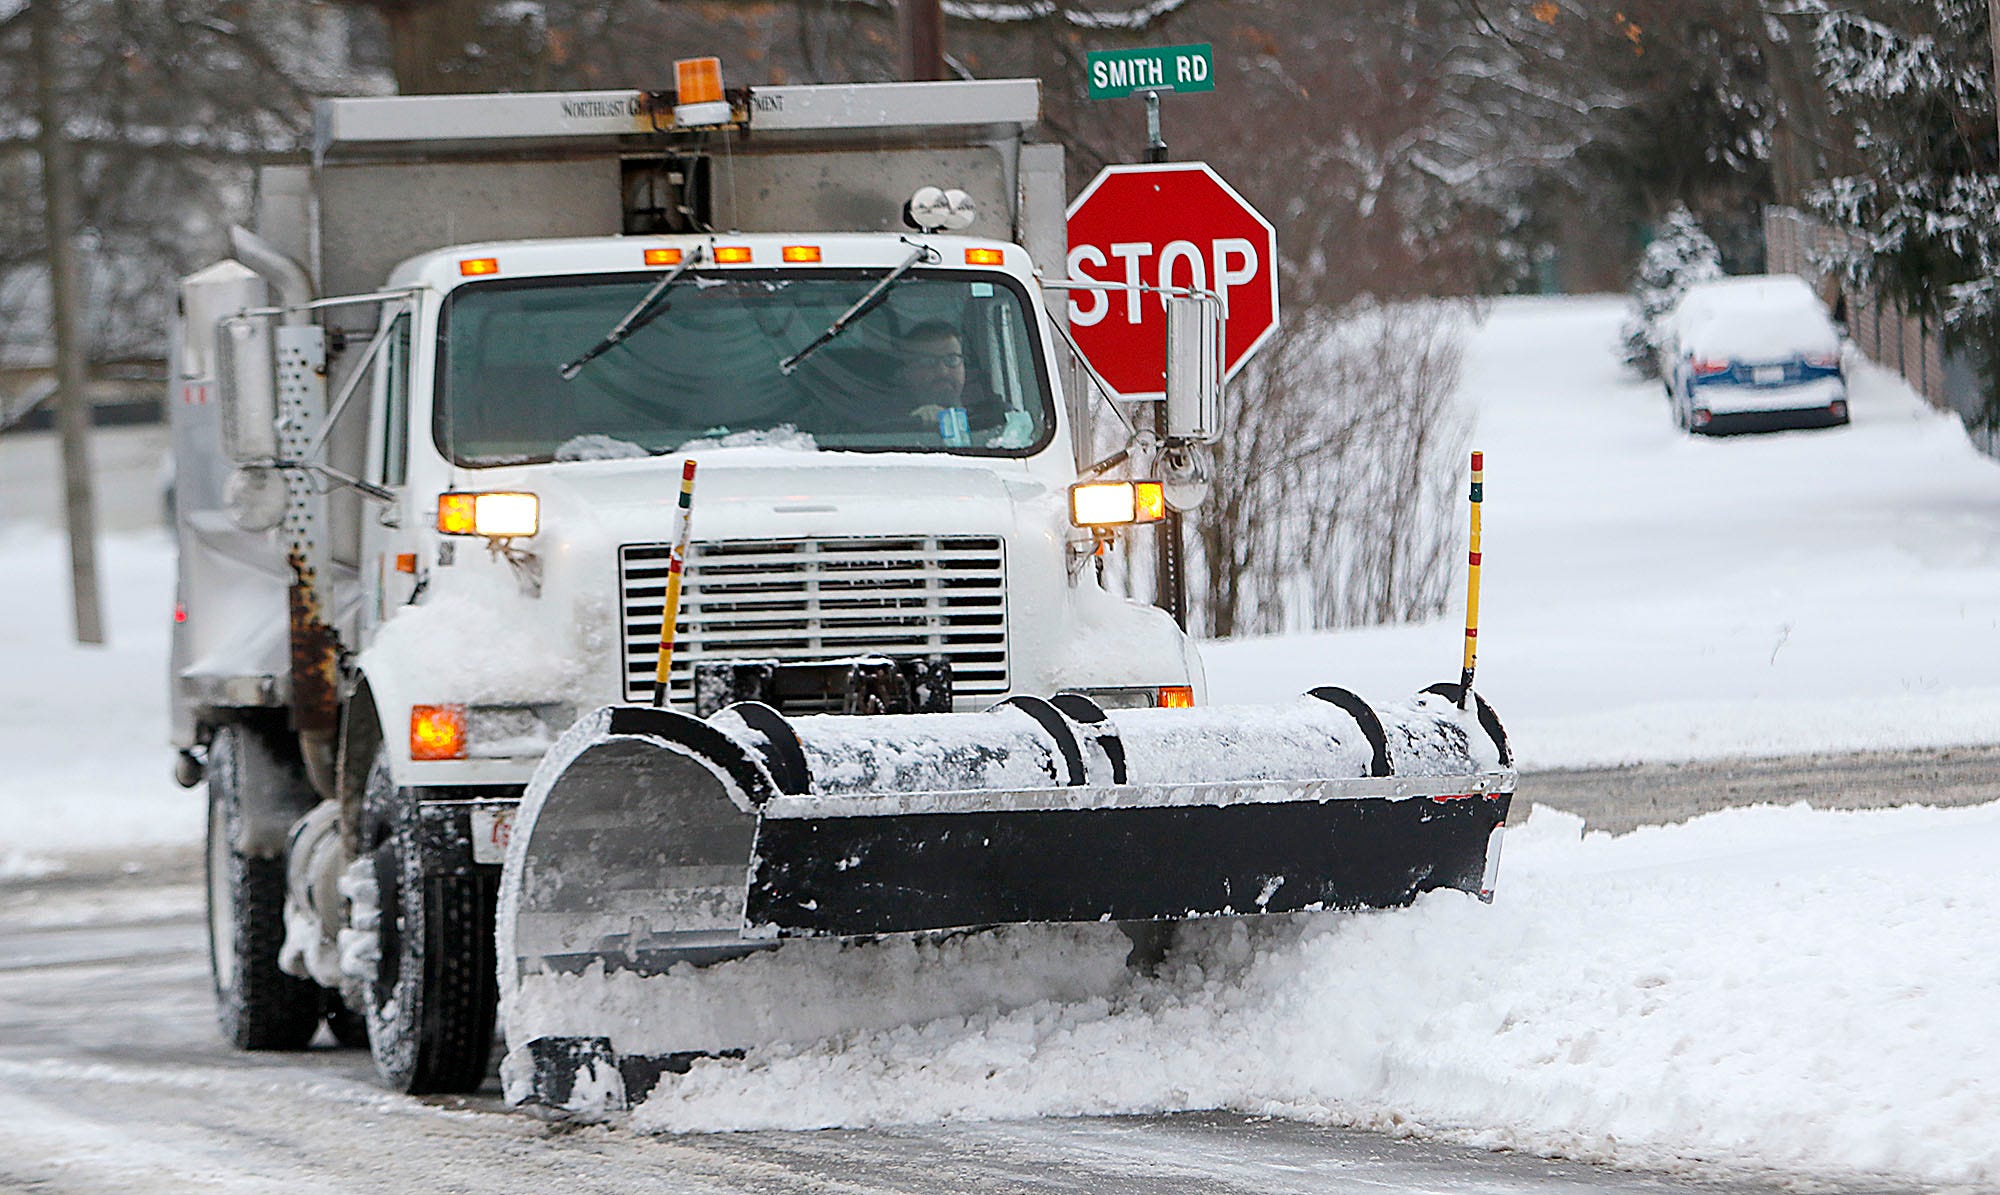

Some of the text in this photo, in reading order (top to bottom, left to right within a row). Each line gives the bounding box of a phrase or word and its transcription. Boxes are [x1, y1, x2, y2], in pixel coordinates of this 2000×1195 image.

[1093, 54, 1208, 88] SMITH RD
[1067, 237, 1259, 327] STOP
